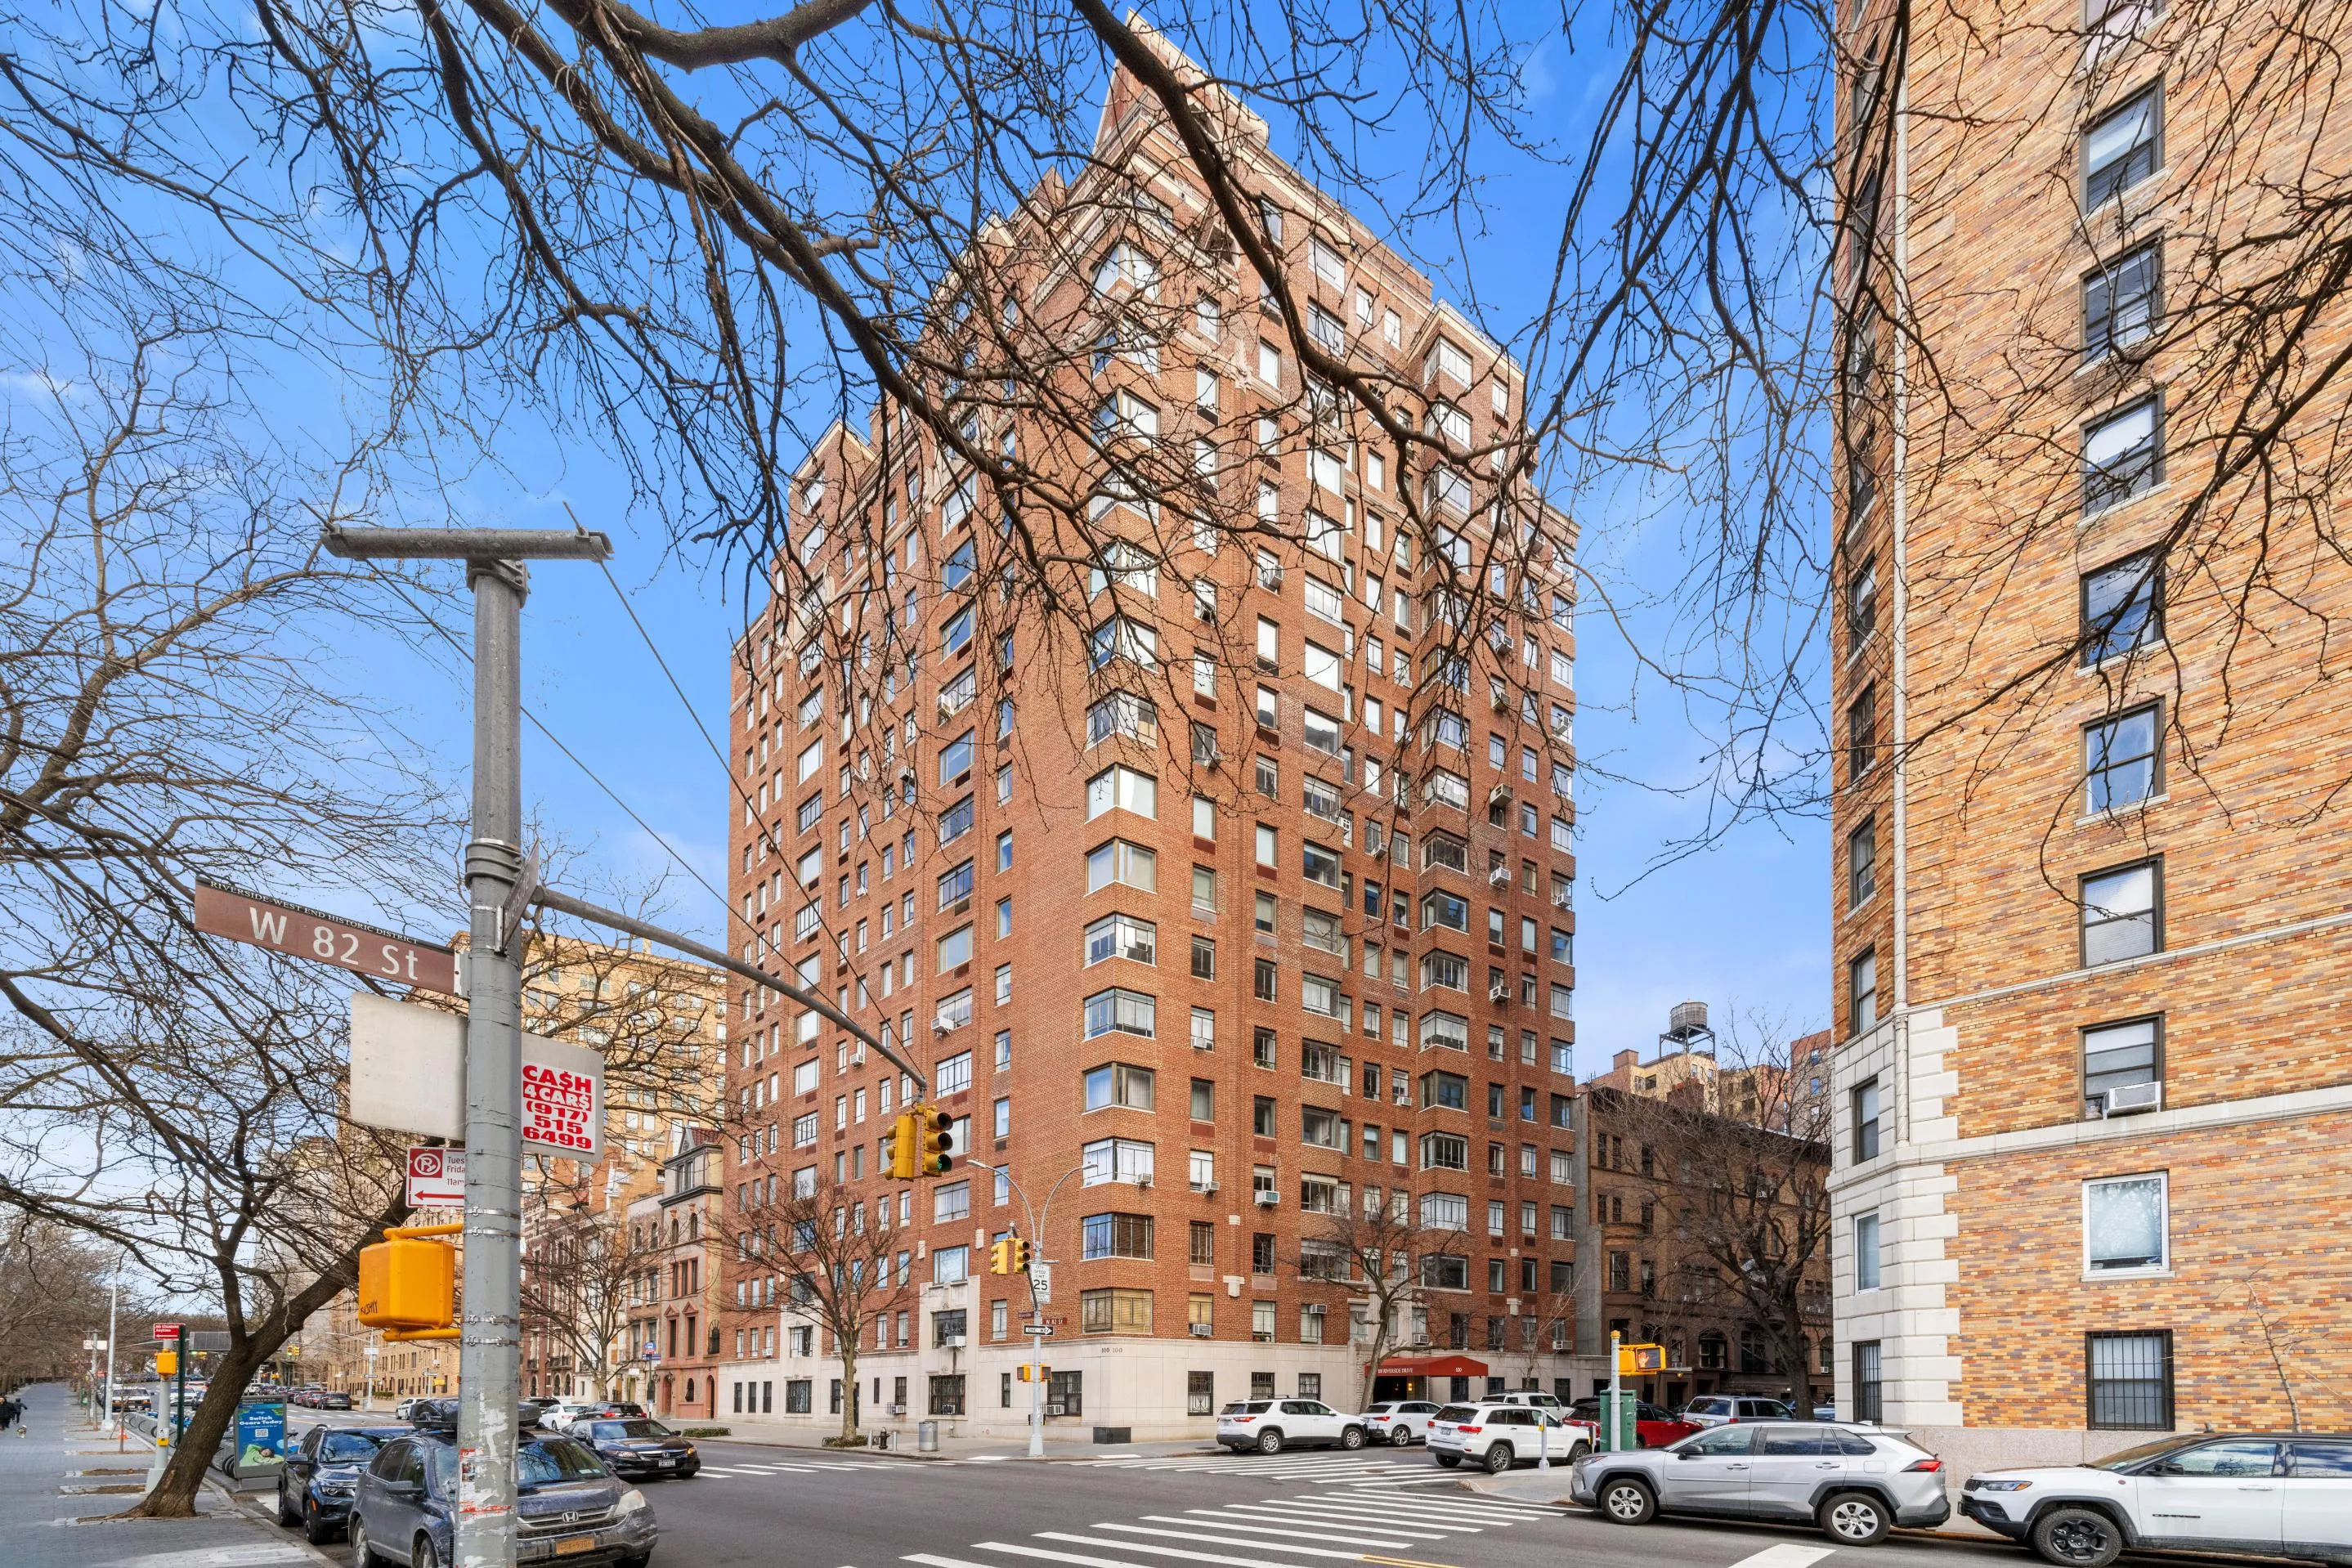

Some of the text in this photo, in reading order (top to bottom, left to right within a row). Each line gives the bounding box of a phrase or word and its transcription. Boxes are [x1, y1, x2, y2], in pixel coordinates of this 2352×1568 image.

[304, 907, 326, 919] END
[327, 915, 374, 932] HISTORIC
[376, 928, 418, 944] DISTRICT
[249, 907, 418, 981] W 82 St
[526, 1100, 589, 1122] (917)
[534, 1114, 583, 1135] 515
[522, 1126, 592, 1149] 6499
[446, 1165, 465, 1173] Frida
[447, 1156, 465, 1164] Tues
[1033, 1279, 1048, 1291] 25
